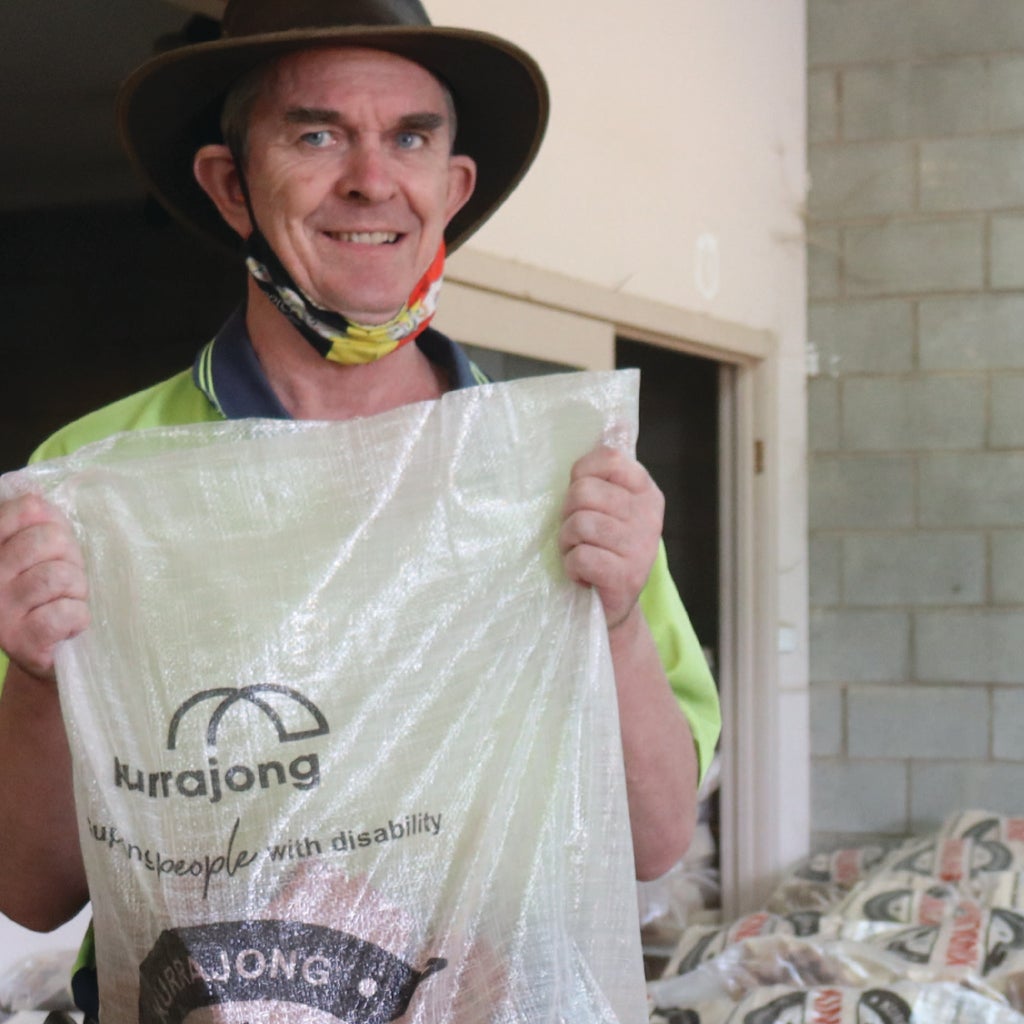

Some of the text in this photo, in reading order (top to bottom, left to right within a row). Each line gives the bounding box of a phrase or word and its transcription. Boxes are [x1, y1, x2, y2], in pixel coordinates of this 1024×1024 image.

[114, 753, 320, 803] kurrajong
[269, 838, 322, 863] with
[332, 811, 443, 852] disability
